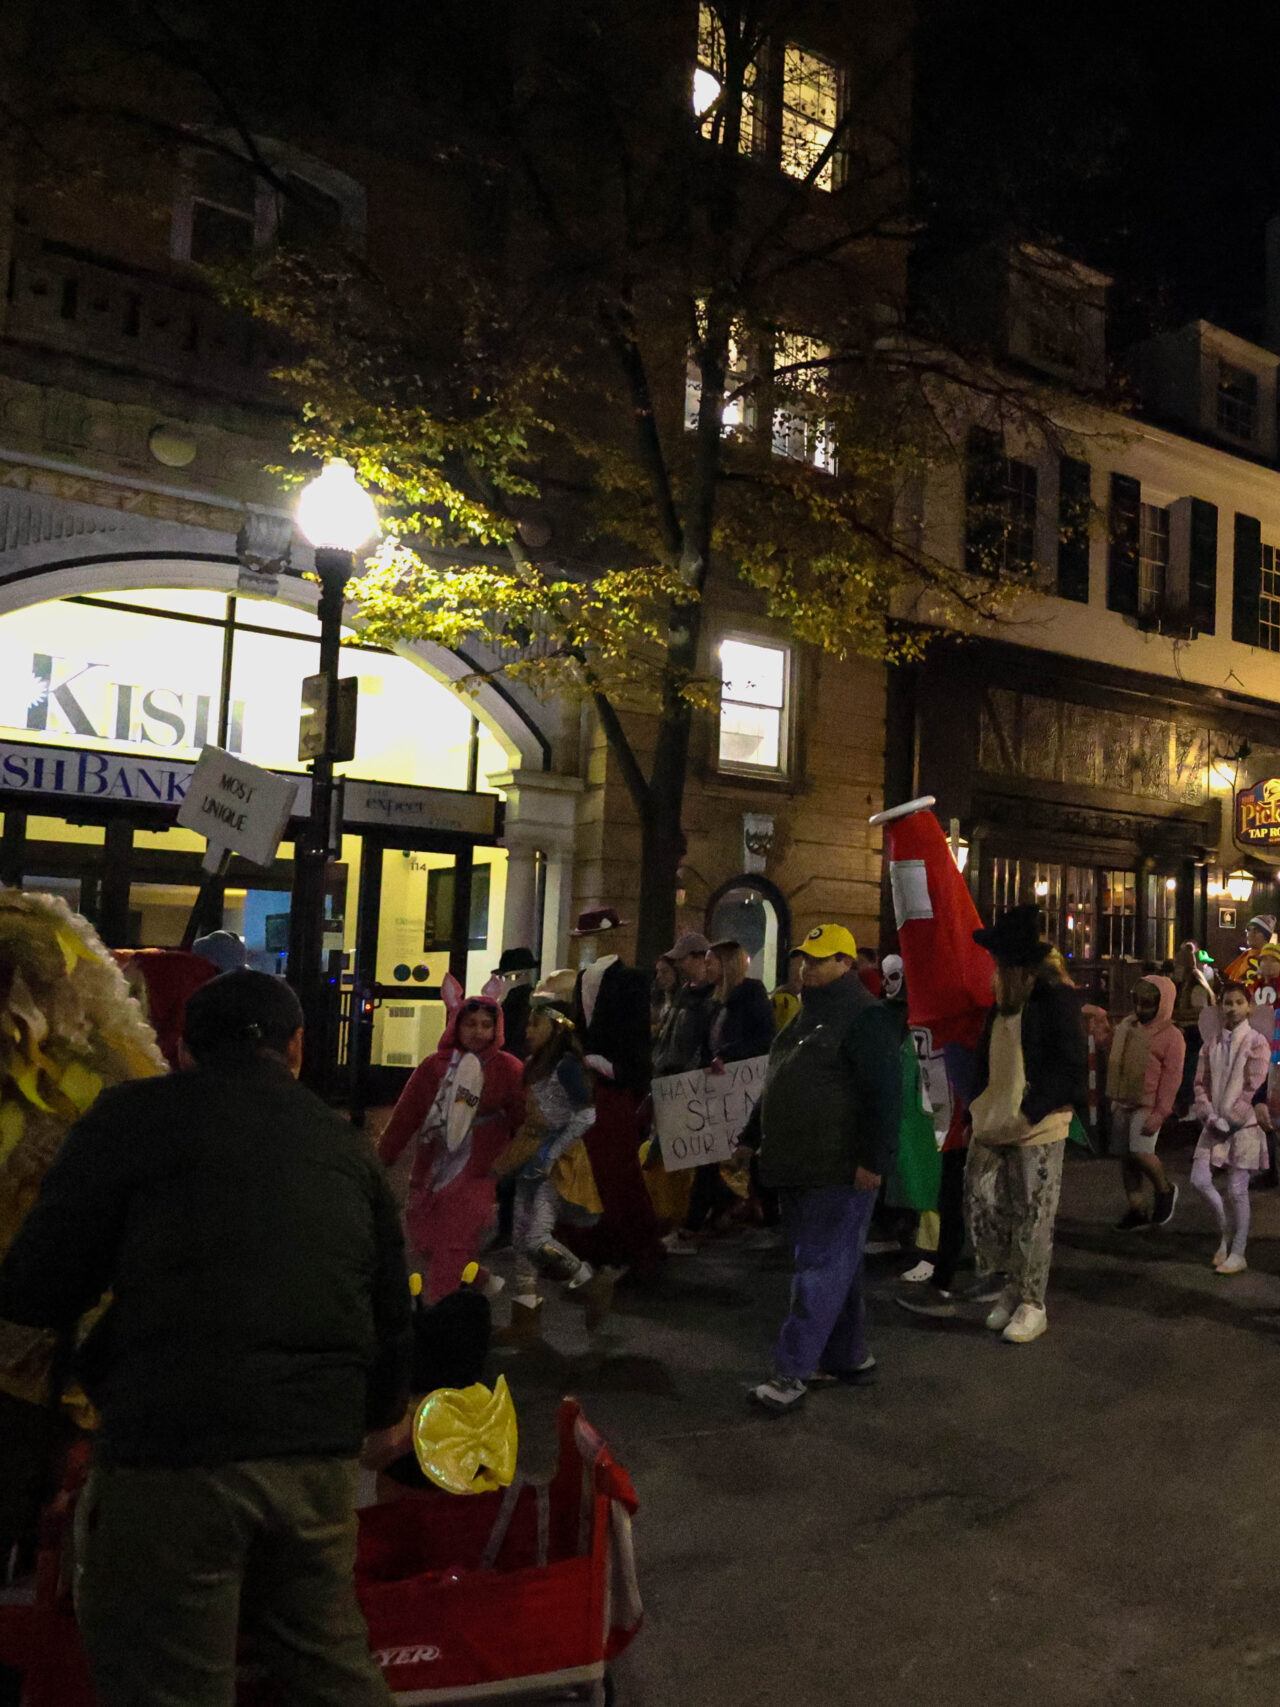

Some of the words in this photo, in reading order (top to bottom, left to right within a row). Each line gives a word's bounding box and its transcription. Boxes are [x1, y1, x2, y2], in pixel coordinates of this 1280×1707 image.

[221, 773, 257, 804] MOST
[201, 795, 250, 832] UNIQUE
[1248, 828, 1268, 839] TAP
[661, 1069, 716, 1101] HAVE
[672, 1133, 716, 1159] OUR
